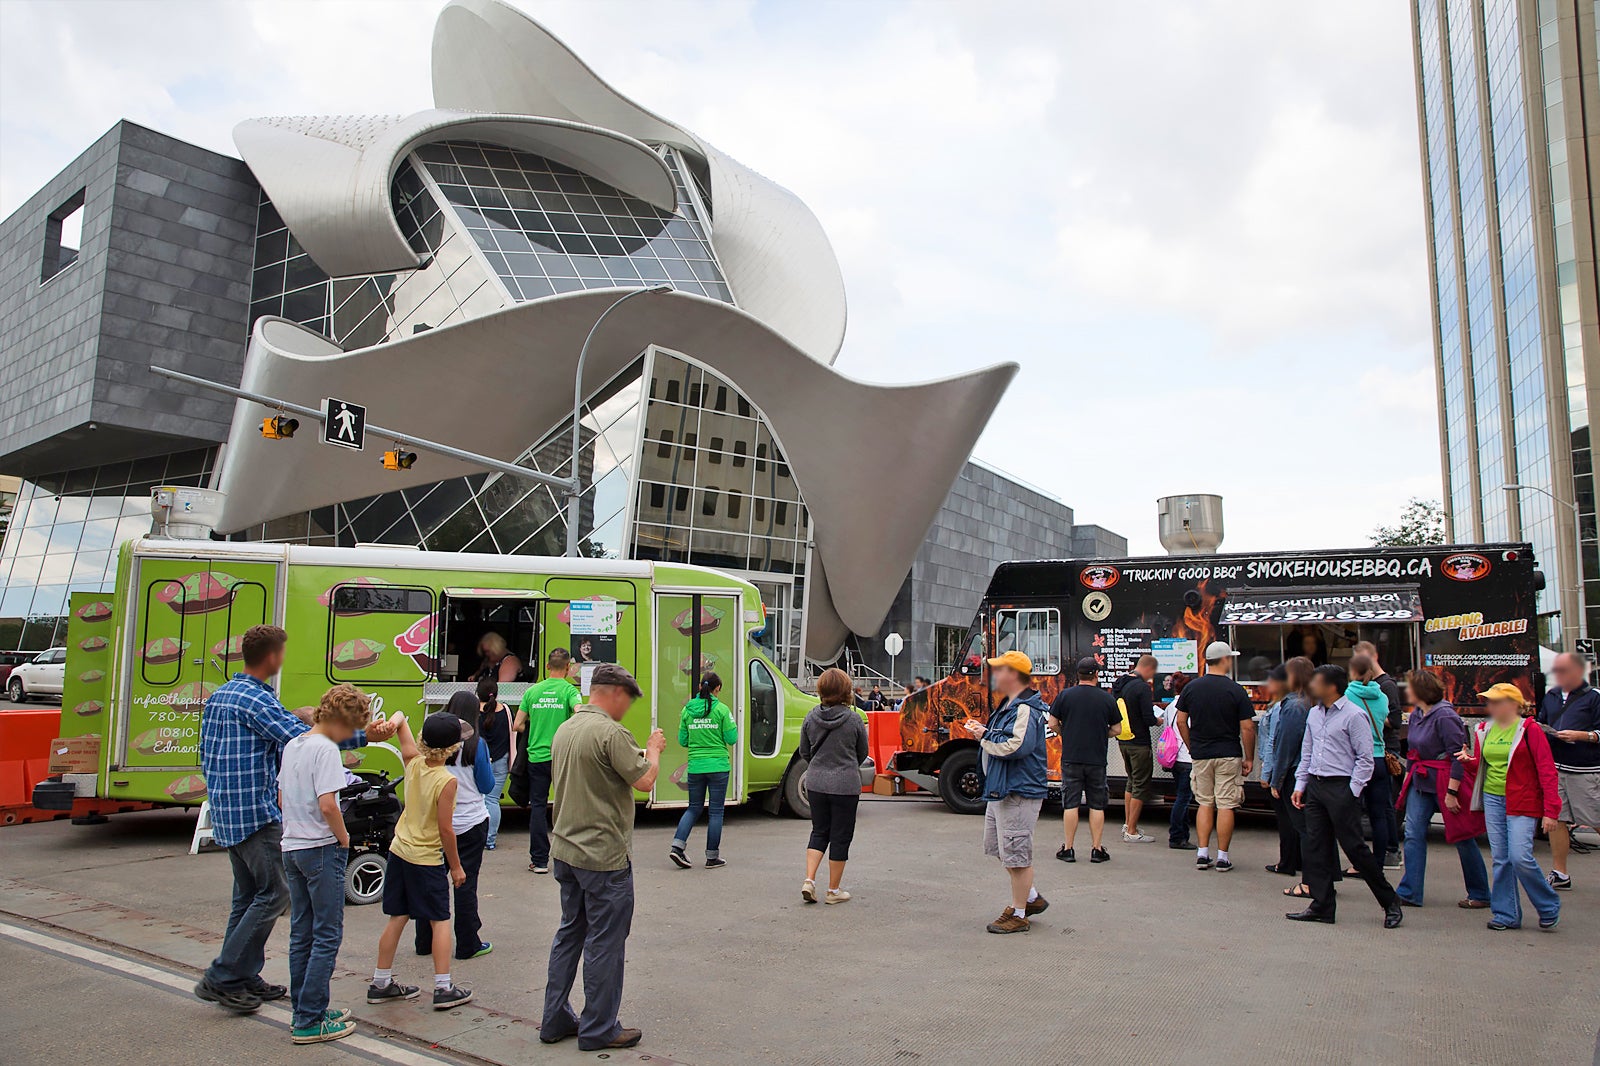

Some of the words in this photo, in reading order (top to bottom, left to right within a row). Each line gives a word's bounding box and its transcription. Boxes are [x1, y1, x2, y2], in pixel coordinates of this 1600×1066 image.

[1179, 567, 1211, 581] GOOD
[1213, 565, 1243, 580] BBQ"
[1247, 558, 1432, 578] SMOKEHOUSEBBQ.CA
[1225, 598, 1267, 611] REAL
[1269, 594, 1354, 608] SOUTHERN
[1359, 592, 1400, 603] BBQ!
[1225, 608, 1413, 622] 587.521.6328
[1425, 612, 1483, 632] CATERING
[1459, 619, 1527, 641] AVAILABLE!
[148, 711, 204, 722] 780-75
